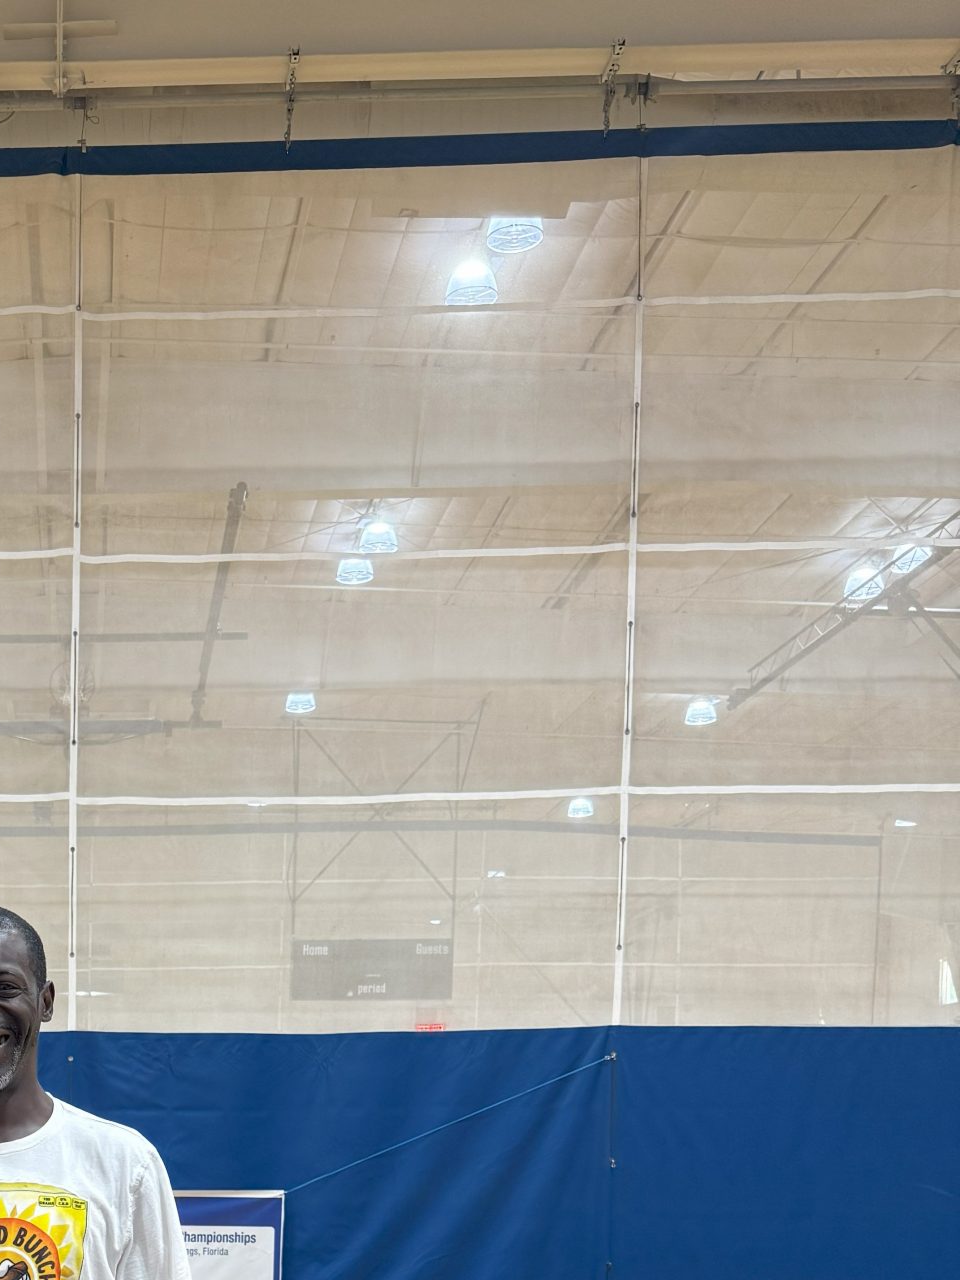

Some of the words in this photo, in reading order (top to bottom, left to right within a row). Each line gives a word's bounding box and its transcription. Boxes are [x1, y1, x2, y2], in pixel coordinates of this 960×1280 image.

[302, 944, 329, 956] Home
[182, 1231, 256, 1246] hampionships
[202, 1247, 229, 1256] Florida
